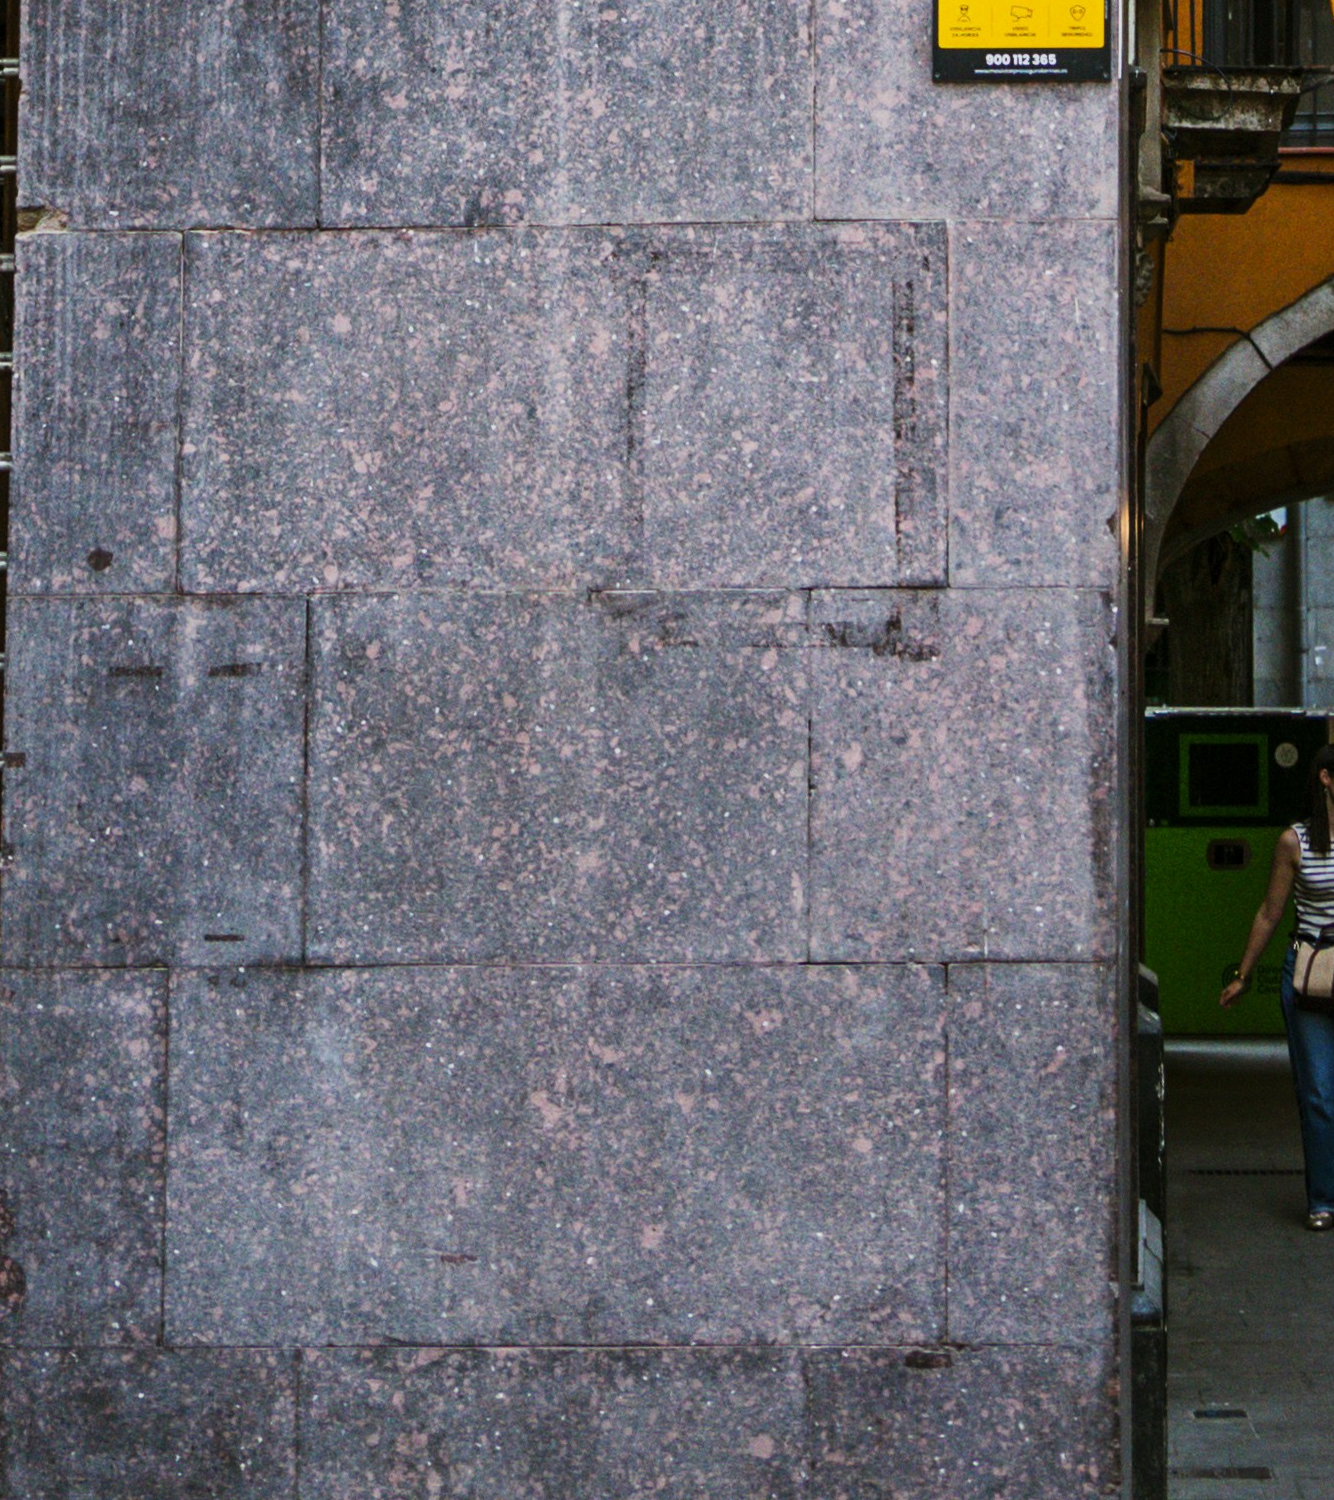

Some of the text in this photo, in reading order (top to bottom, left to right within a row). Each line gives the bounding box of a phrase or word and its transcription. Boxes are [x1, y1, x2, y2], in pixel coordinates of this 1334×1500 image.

[985, 53, 1057, 65] 900 112 365
